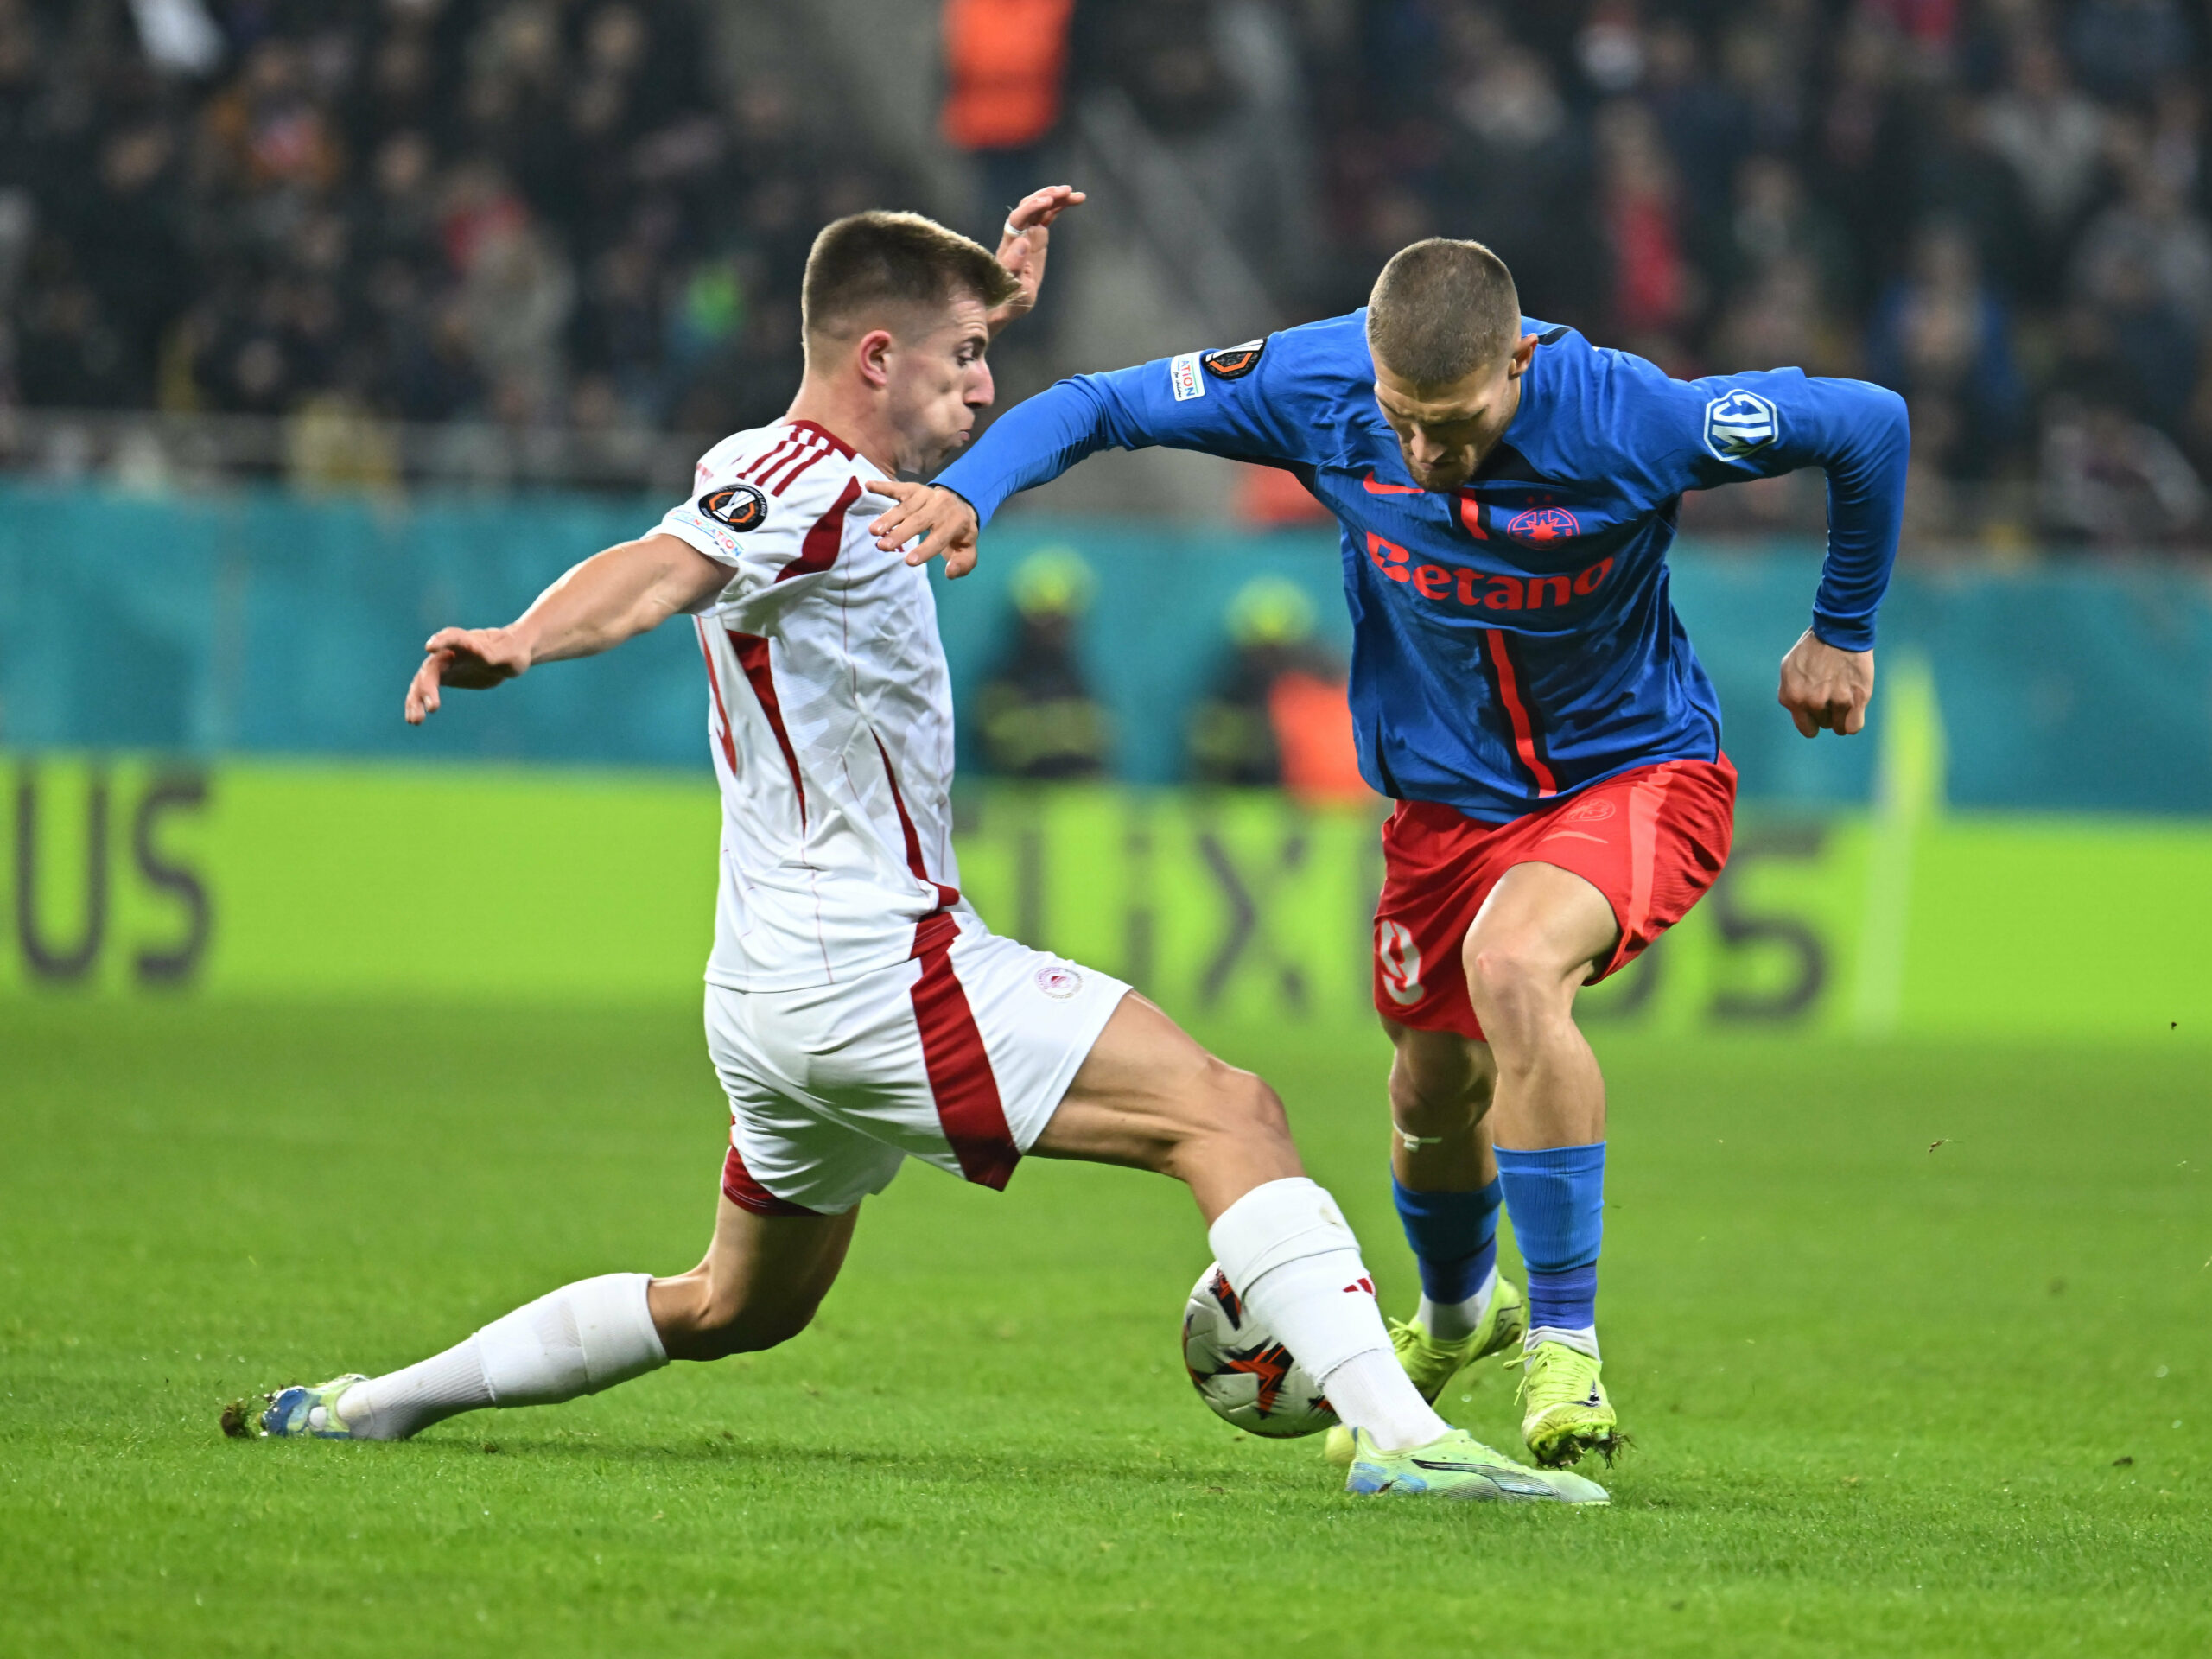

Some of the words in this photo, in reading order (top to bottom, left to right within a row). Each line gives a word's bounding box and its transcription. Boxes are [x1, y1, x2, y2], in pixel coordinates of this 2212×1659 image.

[1712, 394, 1772, 454] MG
[1366, 531, 1614, 610] Betano
[16, 774, 213, 982] US
[1381, 920, 1425, 1005] 9
